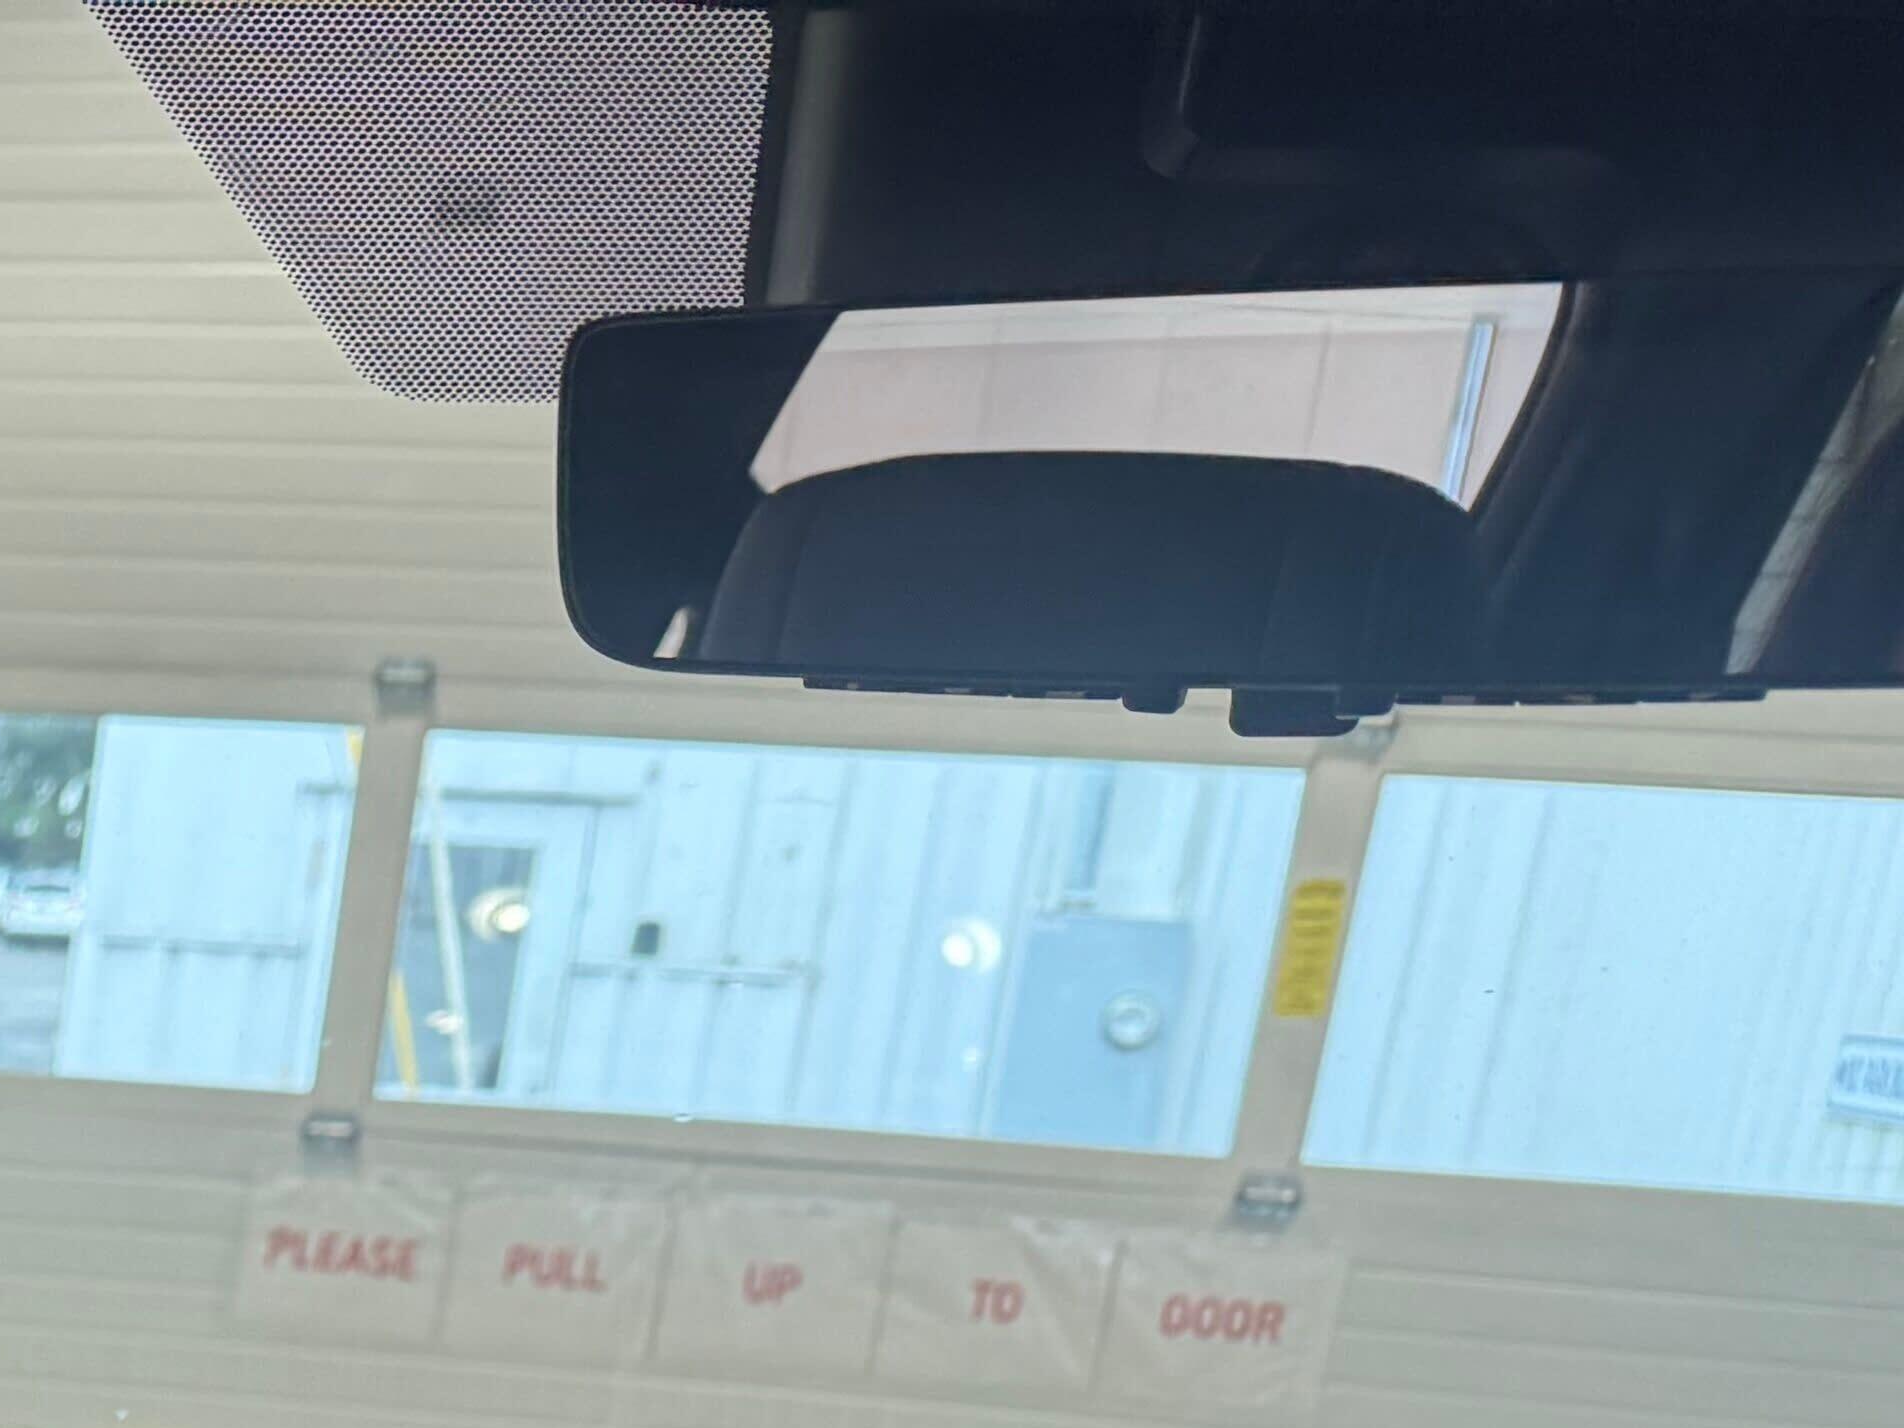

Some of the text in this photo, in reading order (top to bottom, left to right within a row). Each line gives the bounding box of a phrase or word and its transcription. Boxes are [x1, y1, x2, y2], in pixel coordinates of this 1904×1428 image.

[264, 1227, 1287, 1346] PLEASE PULL UP TO DOOR
